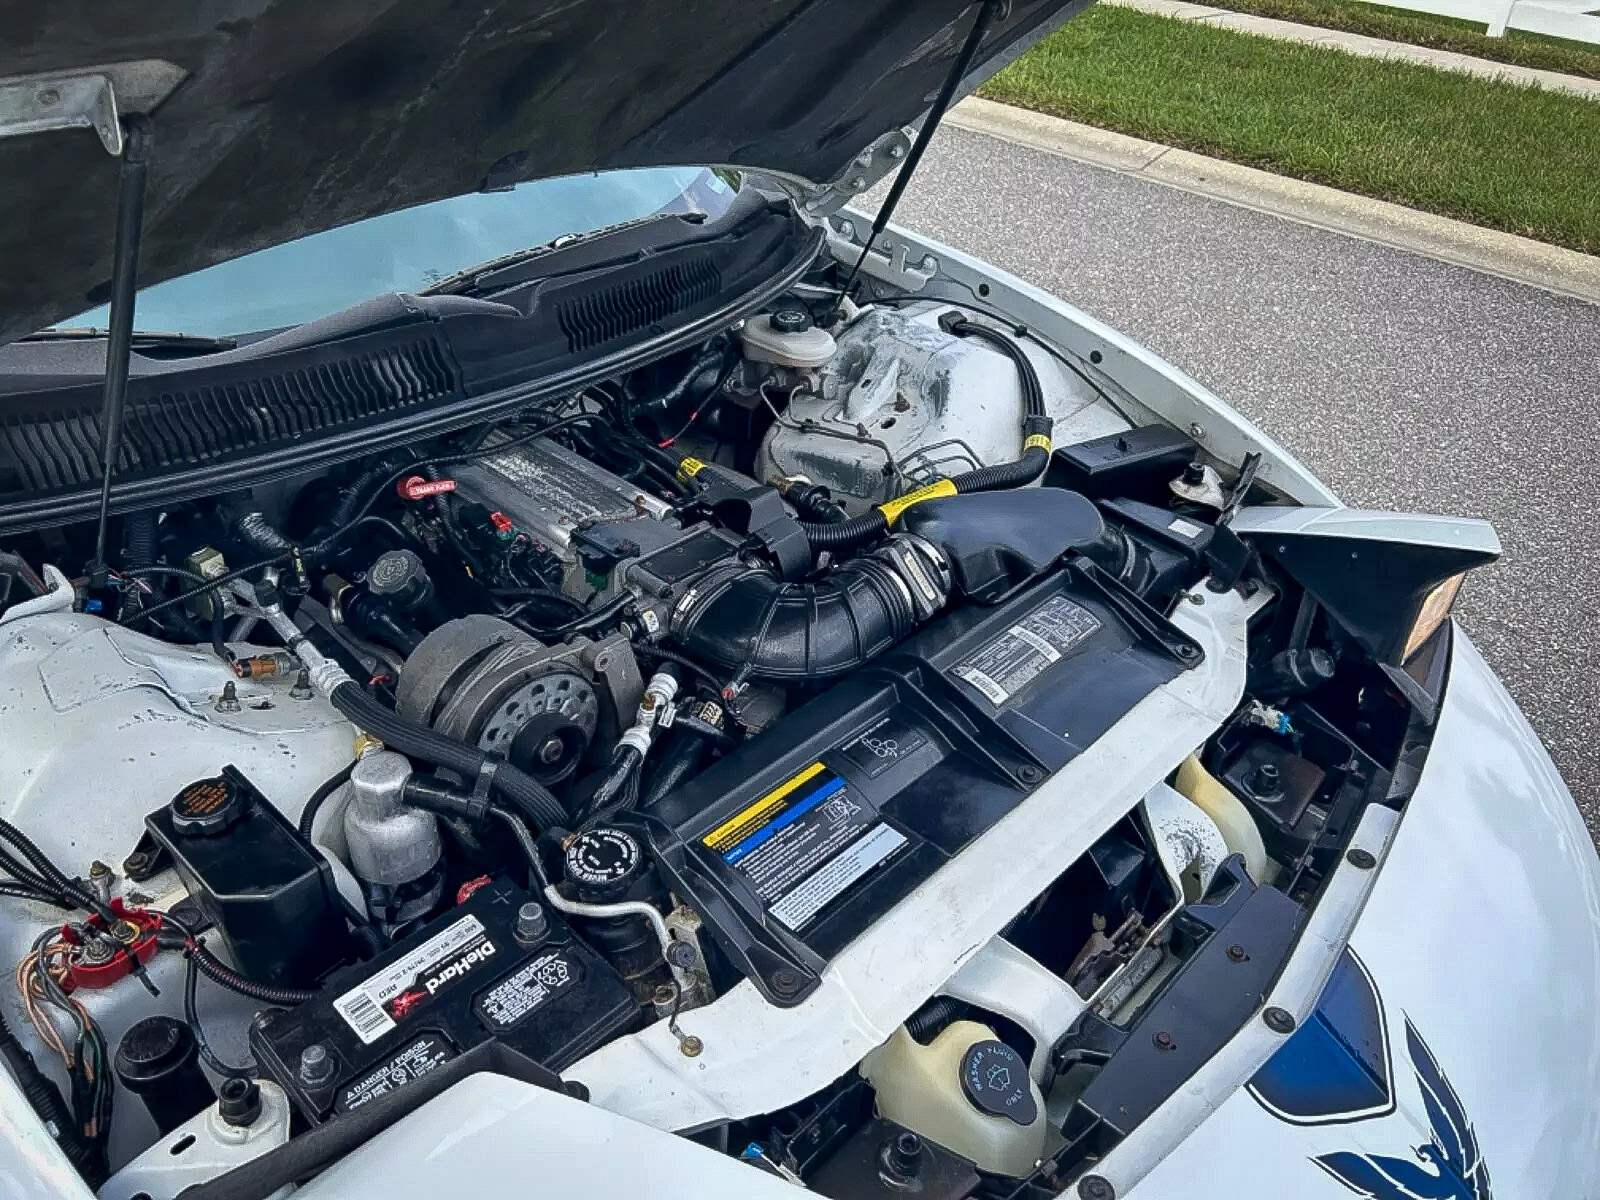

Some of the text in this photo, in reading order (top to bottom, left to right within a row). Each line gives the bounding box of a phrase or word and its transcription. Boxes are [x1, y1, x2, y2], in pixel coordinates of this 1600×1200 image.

[424, 940, 496, 995] DieHard
[352, 1065, 391, 1093] DANGER
[394, 1040, 427, 1064] POISON
[971, 1046, 1023, 1106] WASHER FLUID ONLY
